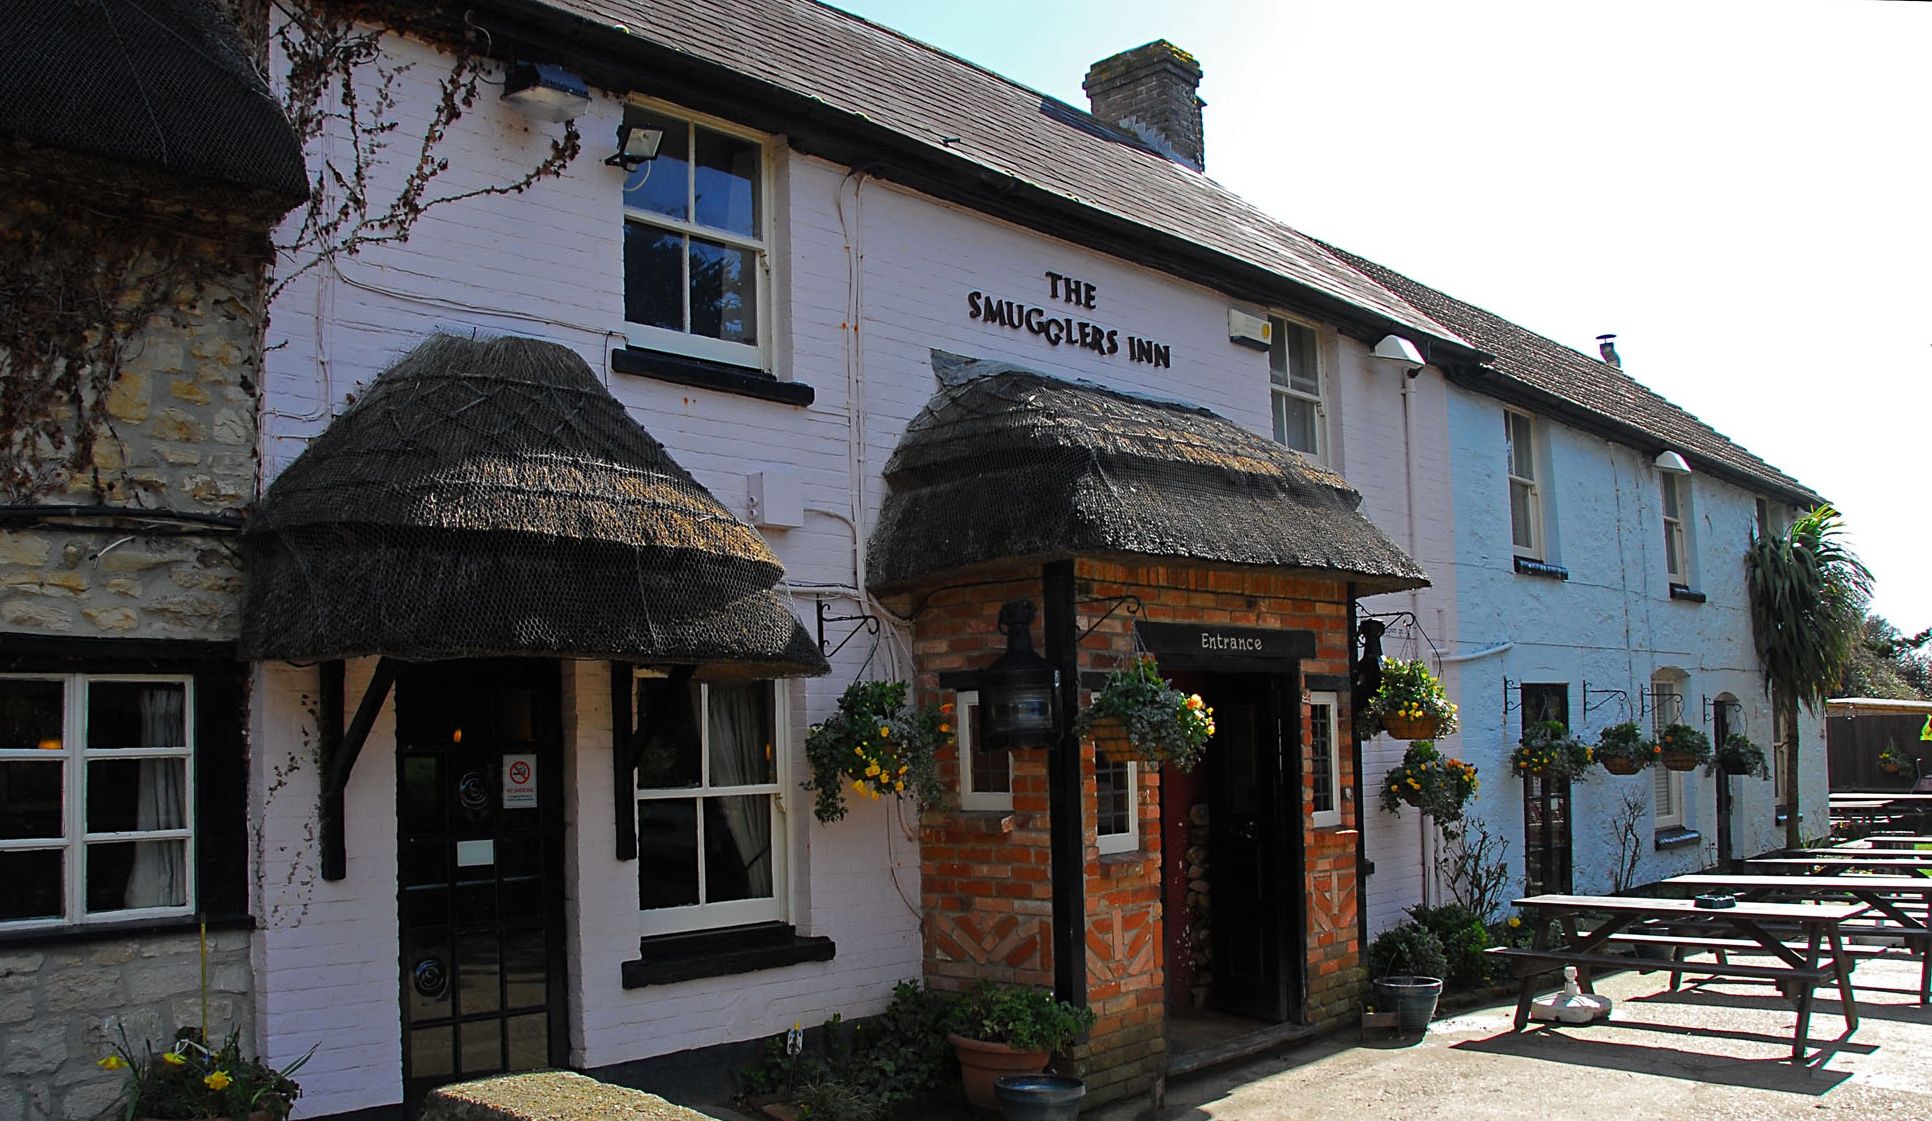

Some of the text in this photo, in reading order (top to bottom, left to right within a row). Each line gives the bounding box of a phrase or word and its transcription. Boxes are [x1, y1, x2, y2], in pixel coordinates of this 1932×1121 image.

[1045, 271, 1097, 310] THE
[967, 290, 1171, 368] SMUGGLERS INN
[1201, 633, 1263, 650] Entrance
